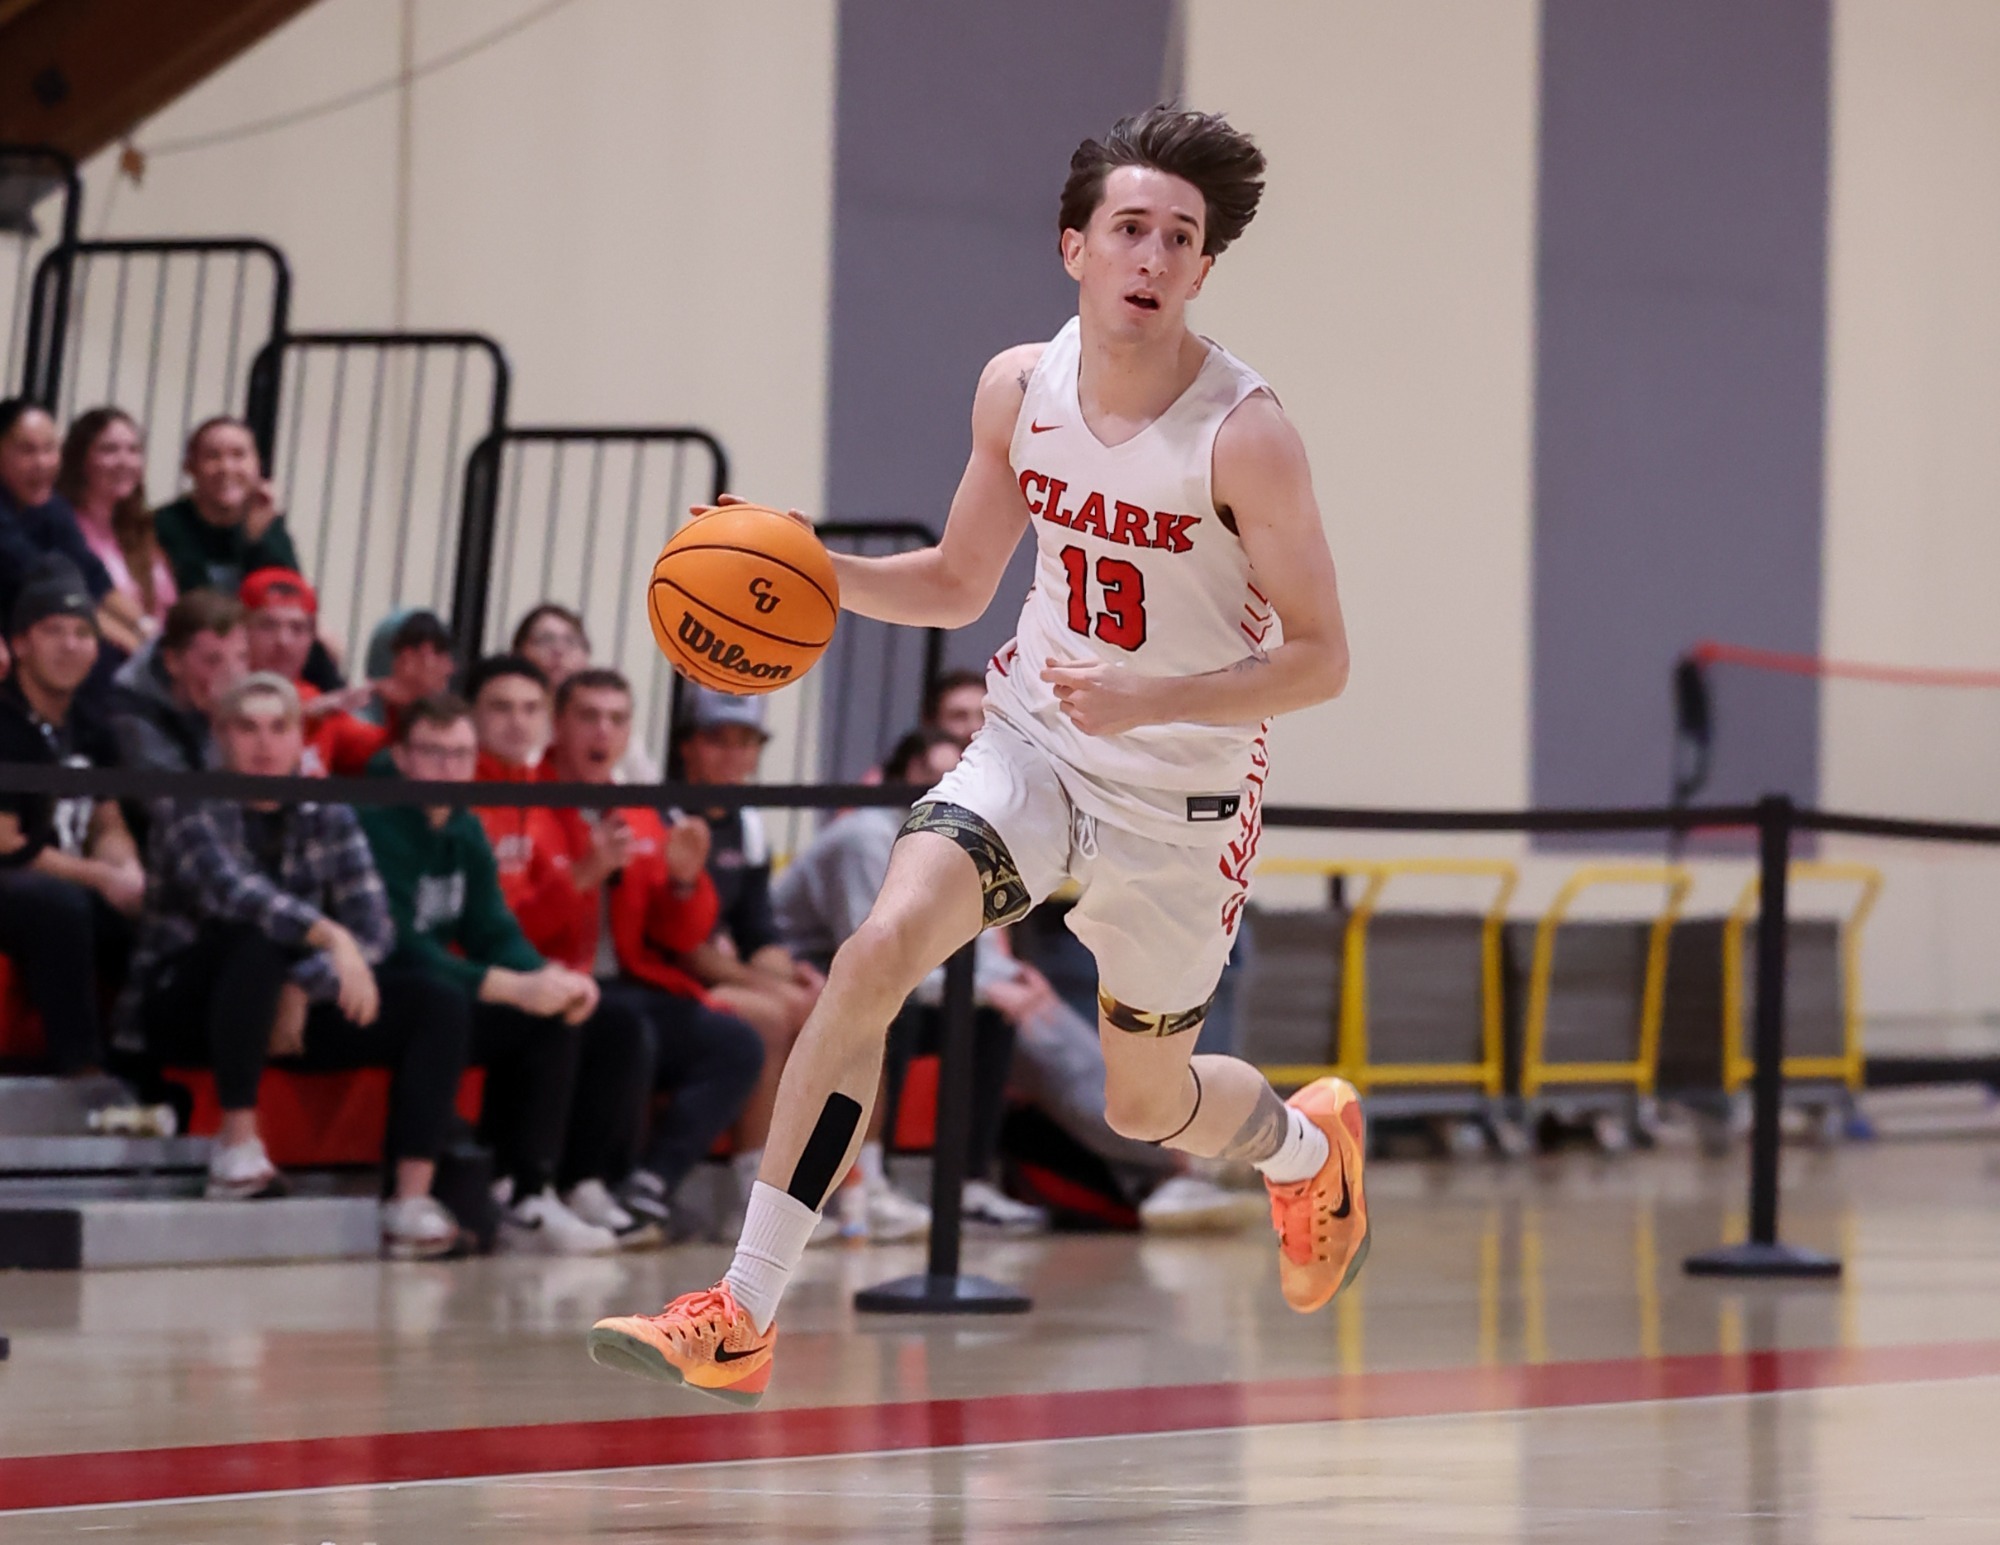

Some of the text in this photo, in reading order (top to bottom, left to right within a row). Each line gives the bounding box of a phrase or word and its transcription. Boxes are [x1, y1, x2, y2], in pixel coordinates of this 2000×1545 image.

[1019, 469, 1202, 553] CLARK
[1060, 545, 1147, 652] 13
[678, 611, 793, 680] Wilson
